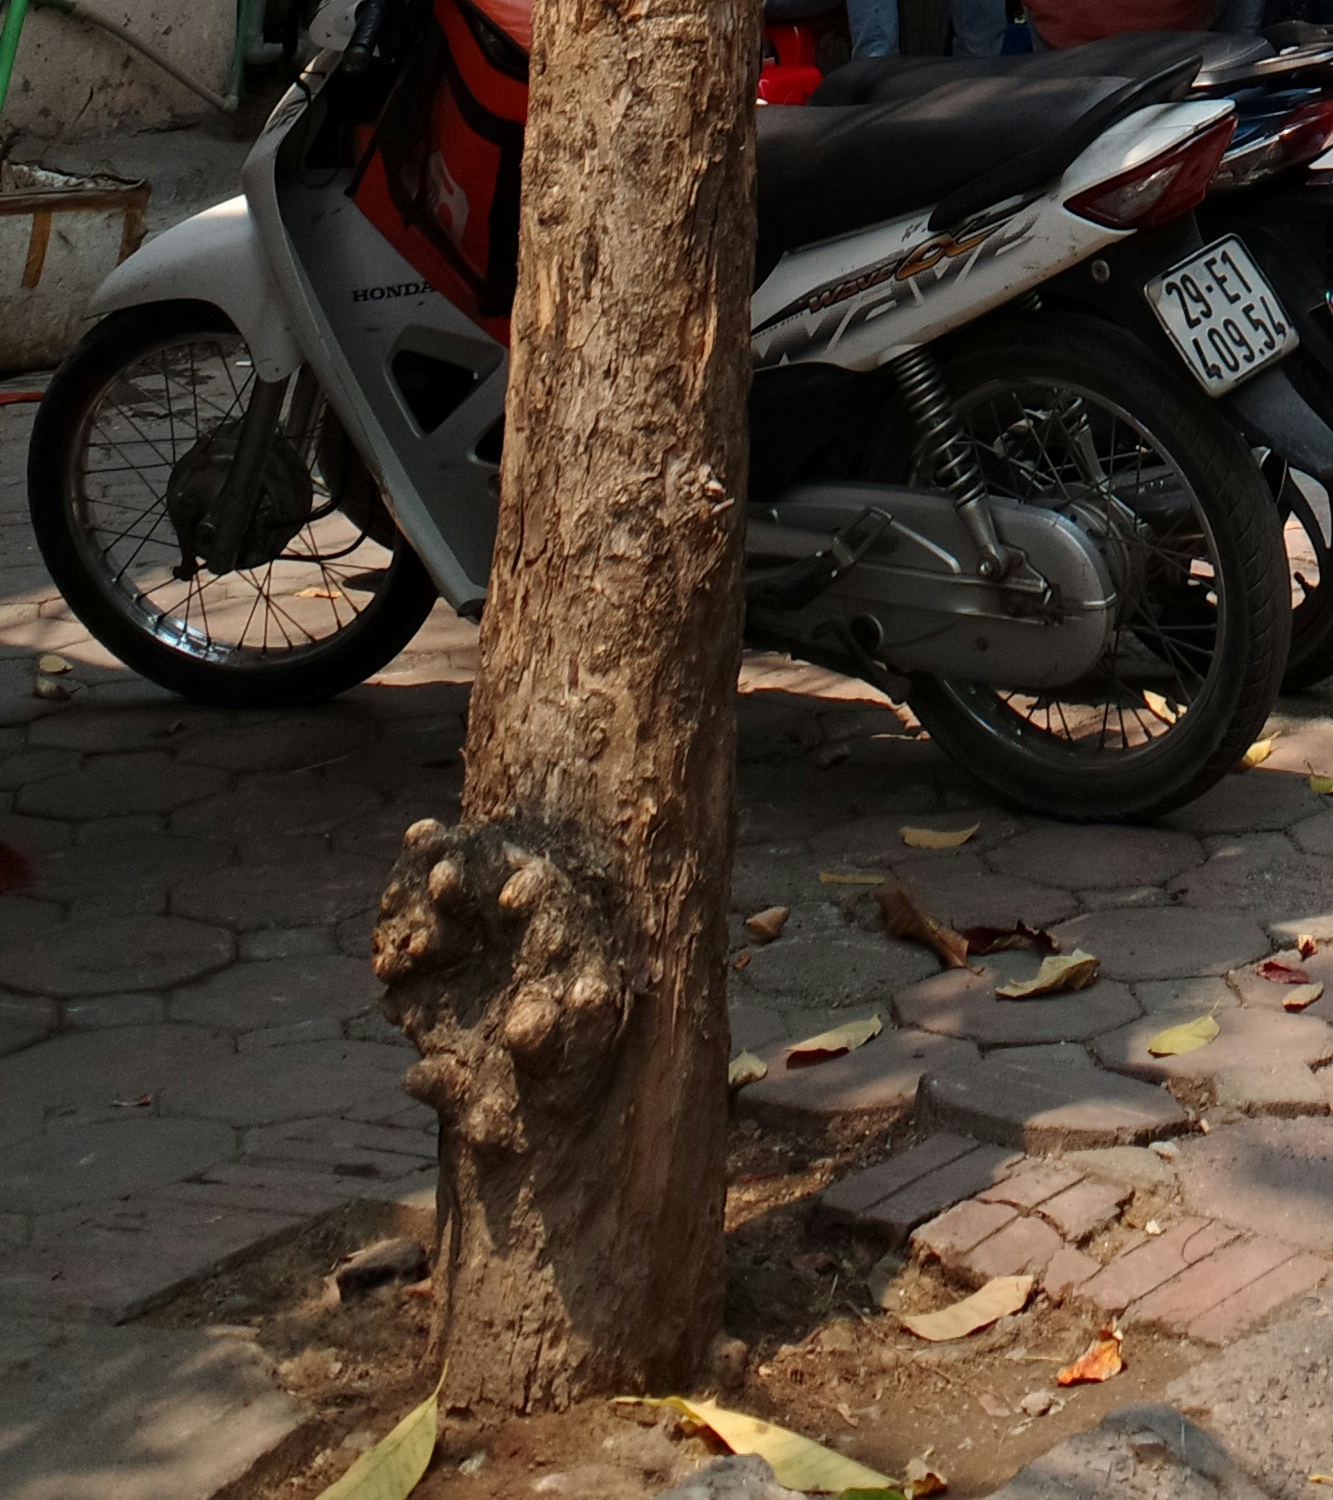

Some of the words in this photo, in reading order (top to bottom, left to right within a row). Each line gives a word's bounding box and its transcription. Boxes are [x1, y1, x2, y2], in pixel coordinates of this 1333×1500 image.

[352, 280, 436, 302] HONDA
[1165, 249, 1253, 330] 29-E1
[1191, 295, 1288, 380] 409.54
